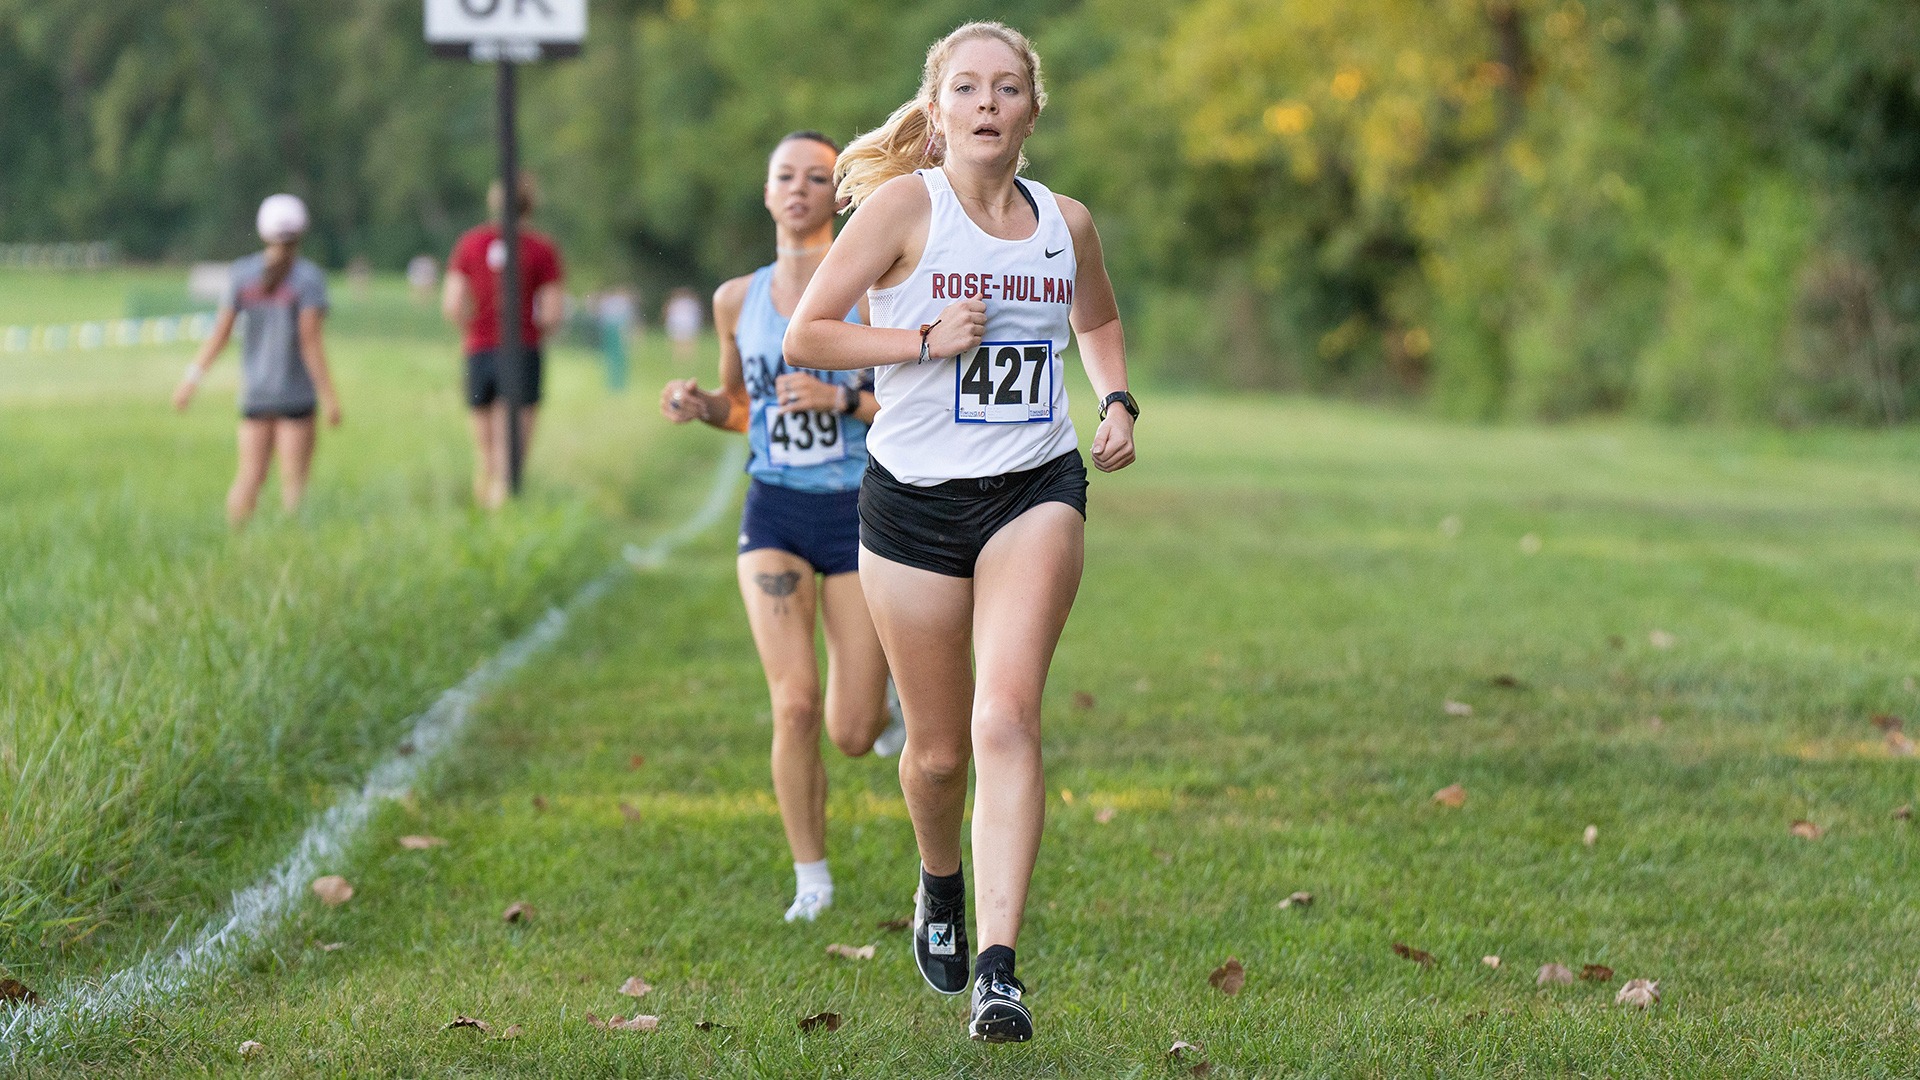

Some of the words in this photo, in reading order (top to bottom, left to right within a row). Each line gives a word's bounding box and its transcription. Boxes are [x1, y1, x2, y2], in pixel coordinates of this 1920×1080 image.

[932, 273, 1073, 305] ROSE-HULMAN
[961, 346, 1048, 405] 427
[770, 410, 838, 451] 439
